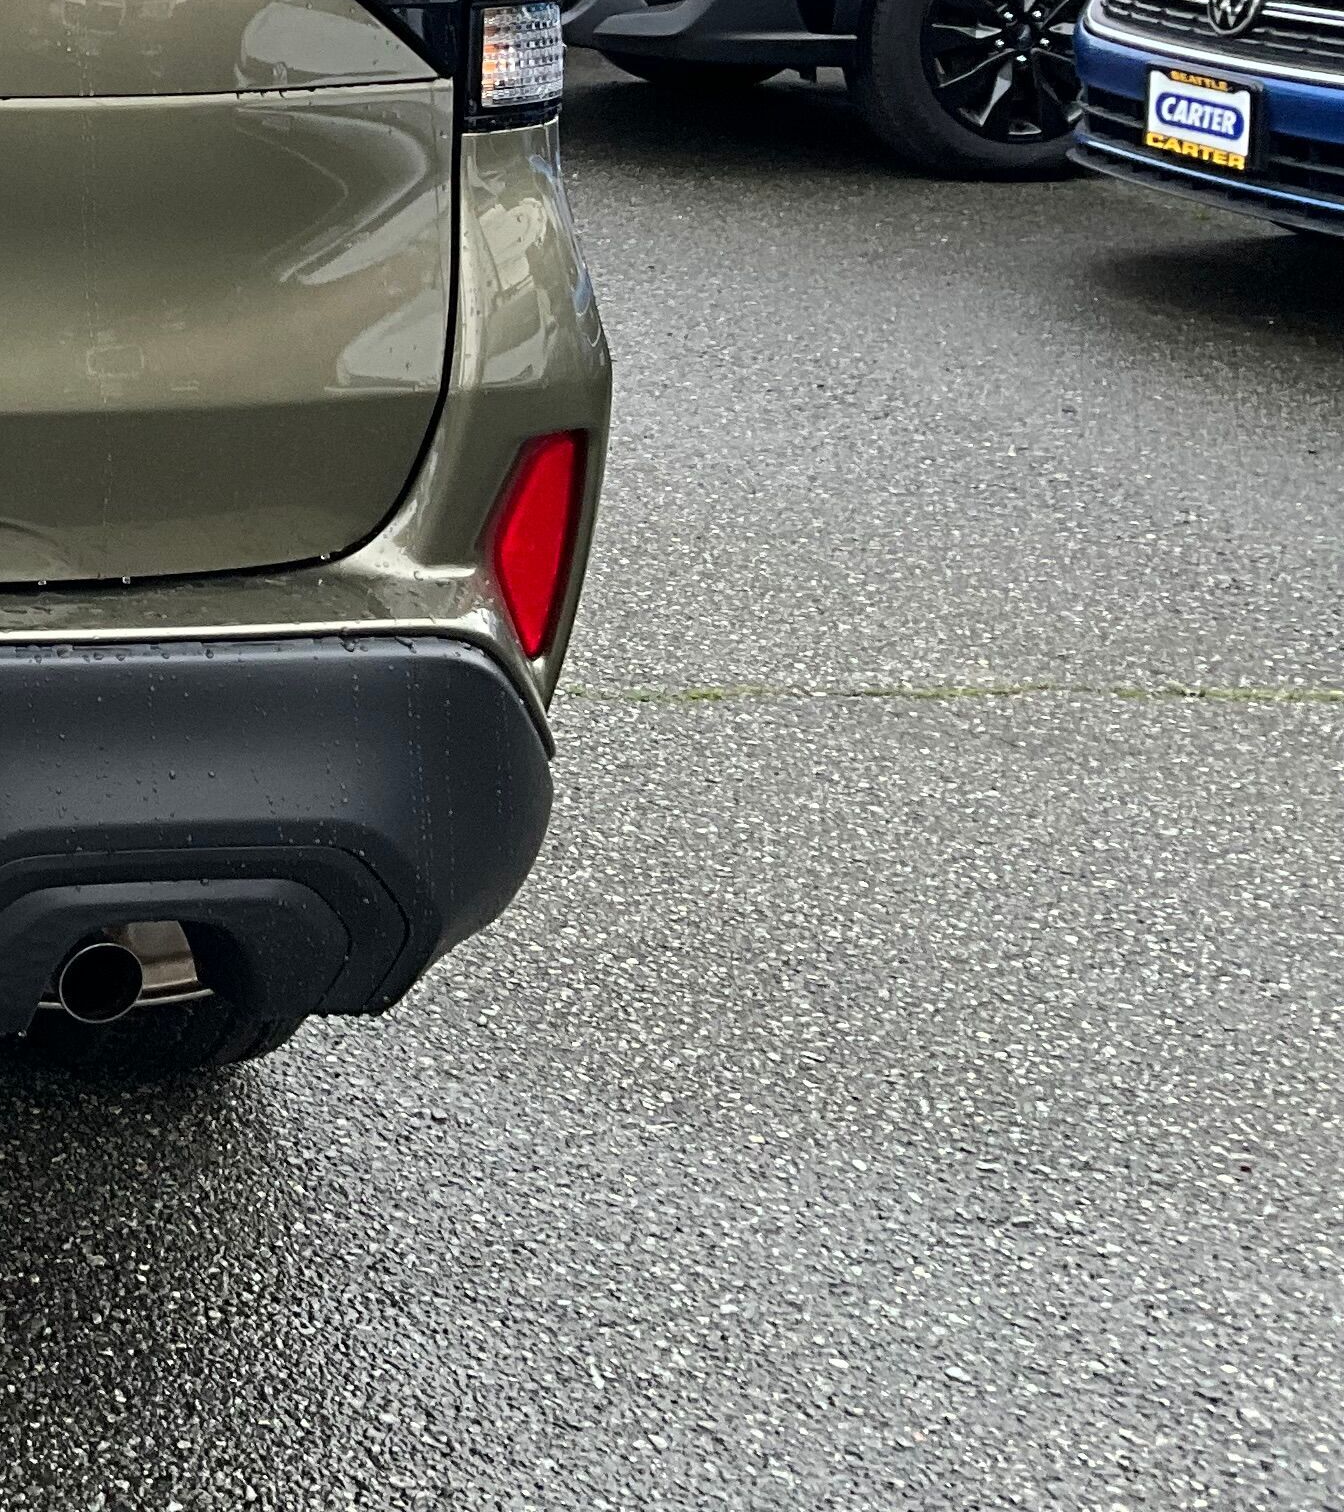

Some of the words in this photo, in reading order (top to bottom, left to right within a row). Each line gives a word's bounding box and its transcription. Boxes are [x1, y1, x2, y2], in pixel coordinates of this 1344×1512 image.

[1170, 70, 1228, 91] SEATTLE
[1162, 96, 1238, 137] CARTER
[1145, 131, 1247, 171] CARTER
